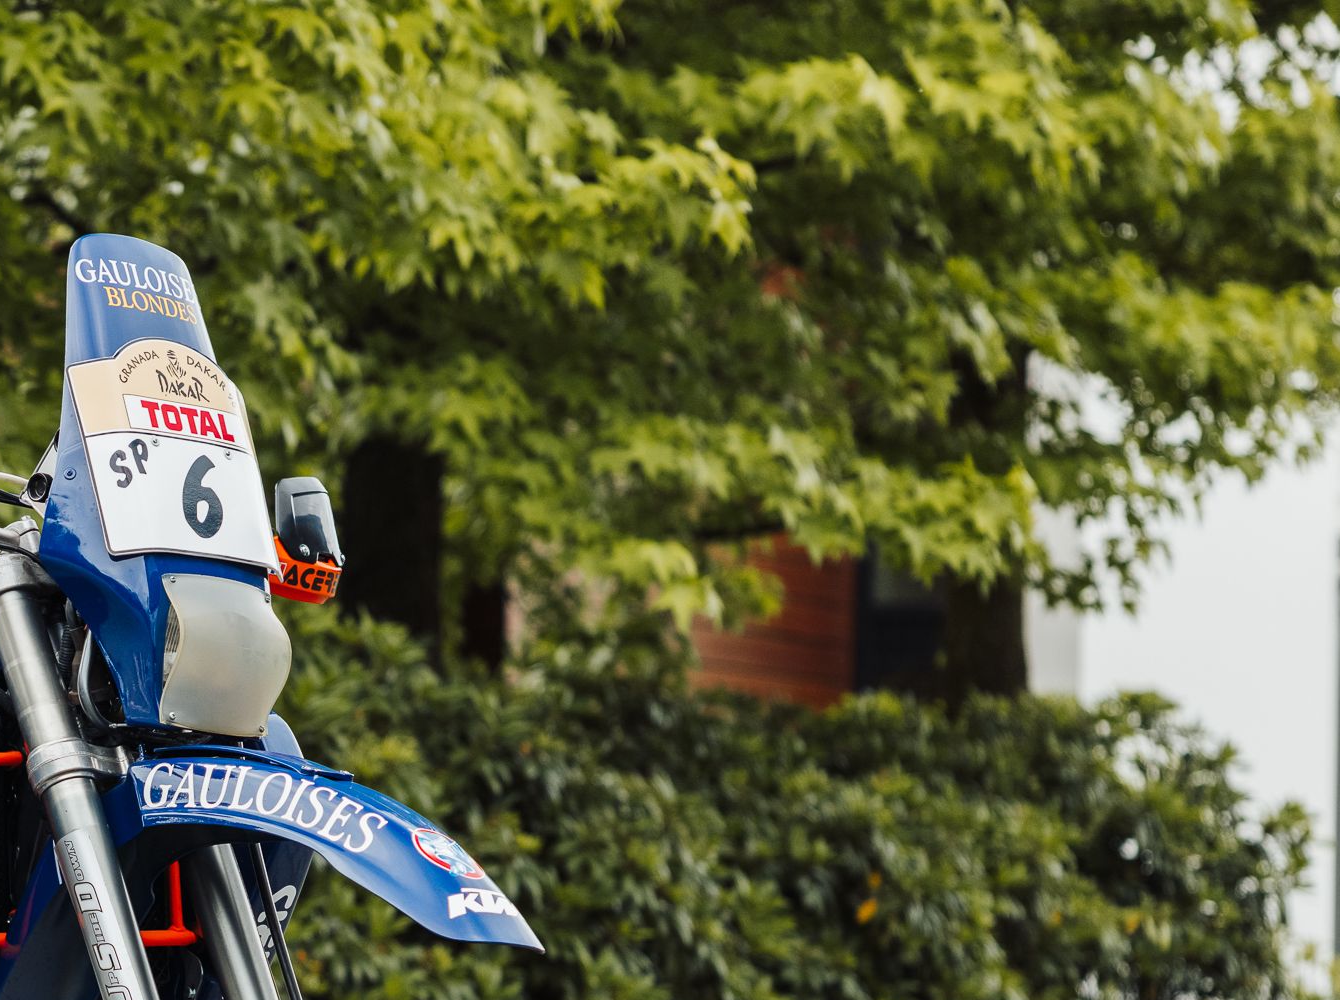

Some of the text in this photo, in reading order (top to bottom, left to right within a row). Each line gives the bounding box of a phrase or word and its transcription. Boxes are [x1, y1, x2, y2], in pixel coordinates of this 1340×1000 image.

[102, 285, 198, 325] BLONDES
[119, 349, 160, 384] GRANADA
[155, 368, 210, 403] DAKAR
[186, 355, 226, 392] DAKAR
[140, 399, 236, 443] TOTAL
[109, 438, 149, 489] SP
[182, 454, 224, 539] 6
[143, 762, 389, 854] GAULOISES
